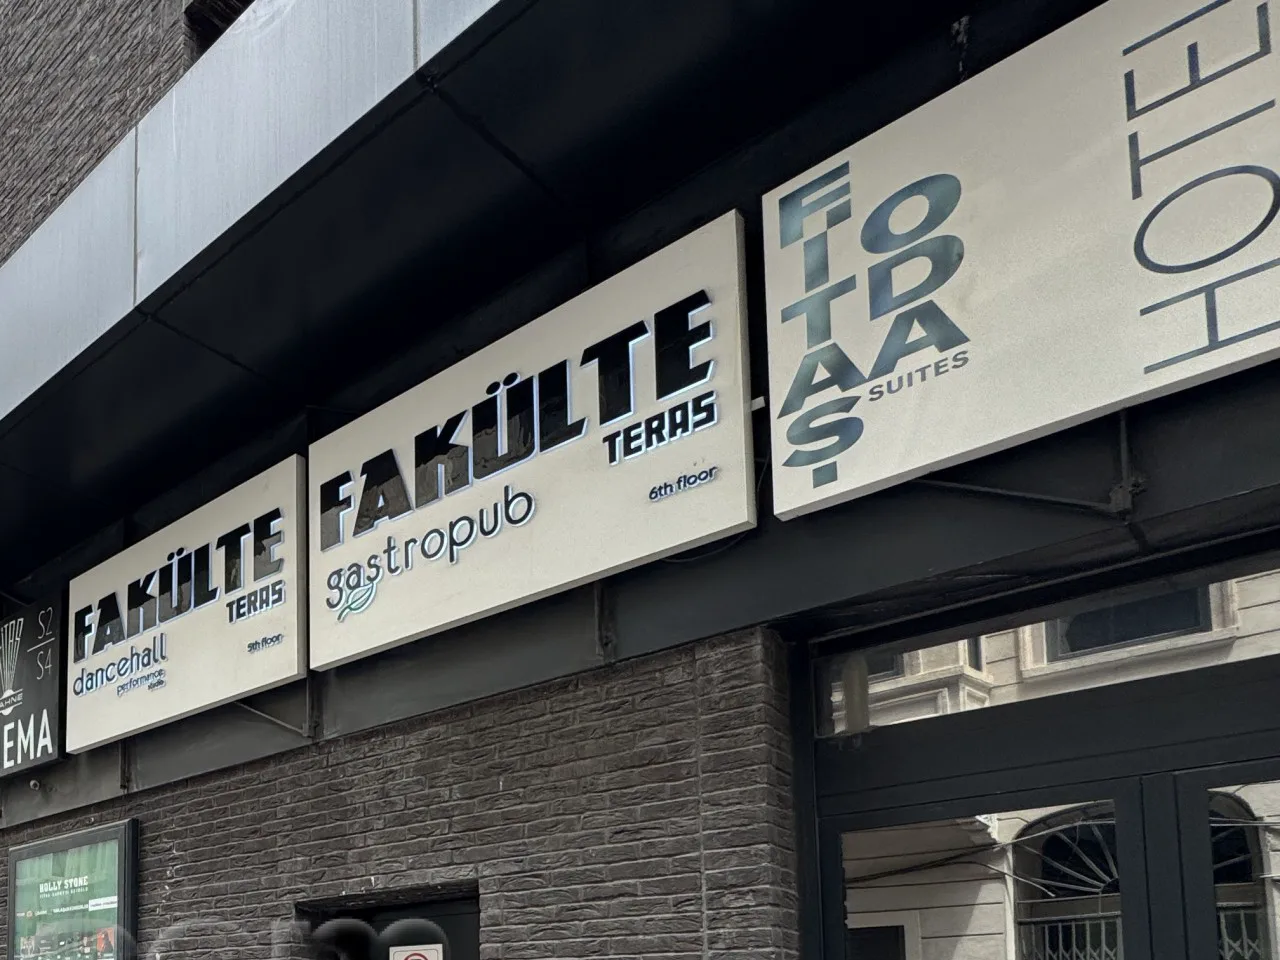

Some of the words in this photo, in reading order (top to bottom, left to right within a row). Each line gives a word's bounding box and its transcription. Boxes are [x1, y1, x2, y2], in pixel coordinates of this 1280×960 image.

[868, 350, 970, 402] SUITES
[320, 288, 715, 554] FAKÜLTE
[602, 390, 719, 466] TERAS
[649, 482, 674, 501] 6th
[676, 466, 718, 490] floor
[325, 485, 537, 609] gastropub
[73, 507, 284, 664] FAKÜLTE
[226, 579, 286, 624] TERAS
[38, 606, 54, 640] S2
[247, 640, 261, 652] 5th
[261, 633, 282, 649] floor
[36, 648, 52, 680] S4
[73, 632, 168, 697] dancehall
[116, 669, 164, 697] performance
[39, 880, 62, 893] HOLLY
[64, 875, 89, 889] STONE
